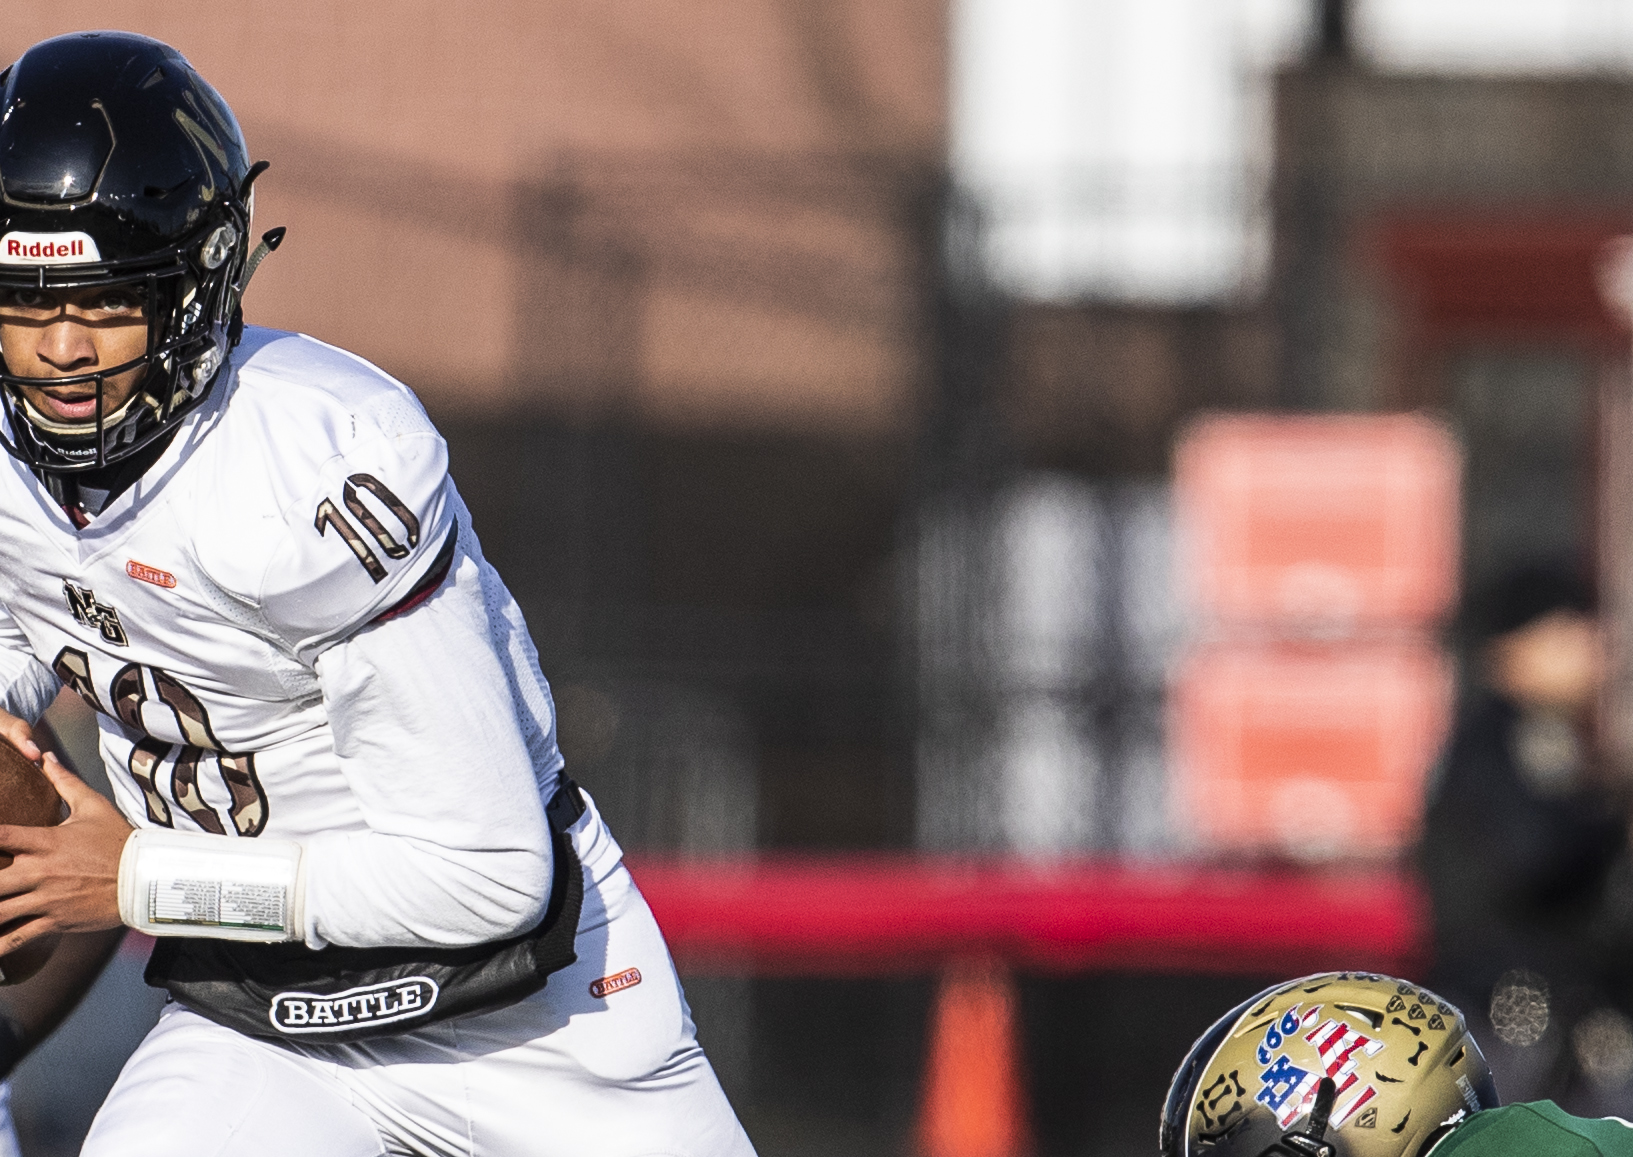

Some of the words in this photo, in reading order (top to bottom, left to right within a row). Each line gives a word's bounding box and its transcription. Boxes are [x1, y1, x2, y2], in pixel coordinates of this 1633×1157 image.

[8, 239, 84, 258] Riddell
[313, 473, 420, 584] 10
[52, 645, 269, 838] 10
[283, 984, 422, 1025] BATTLE
